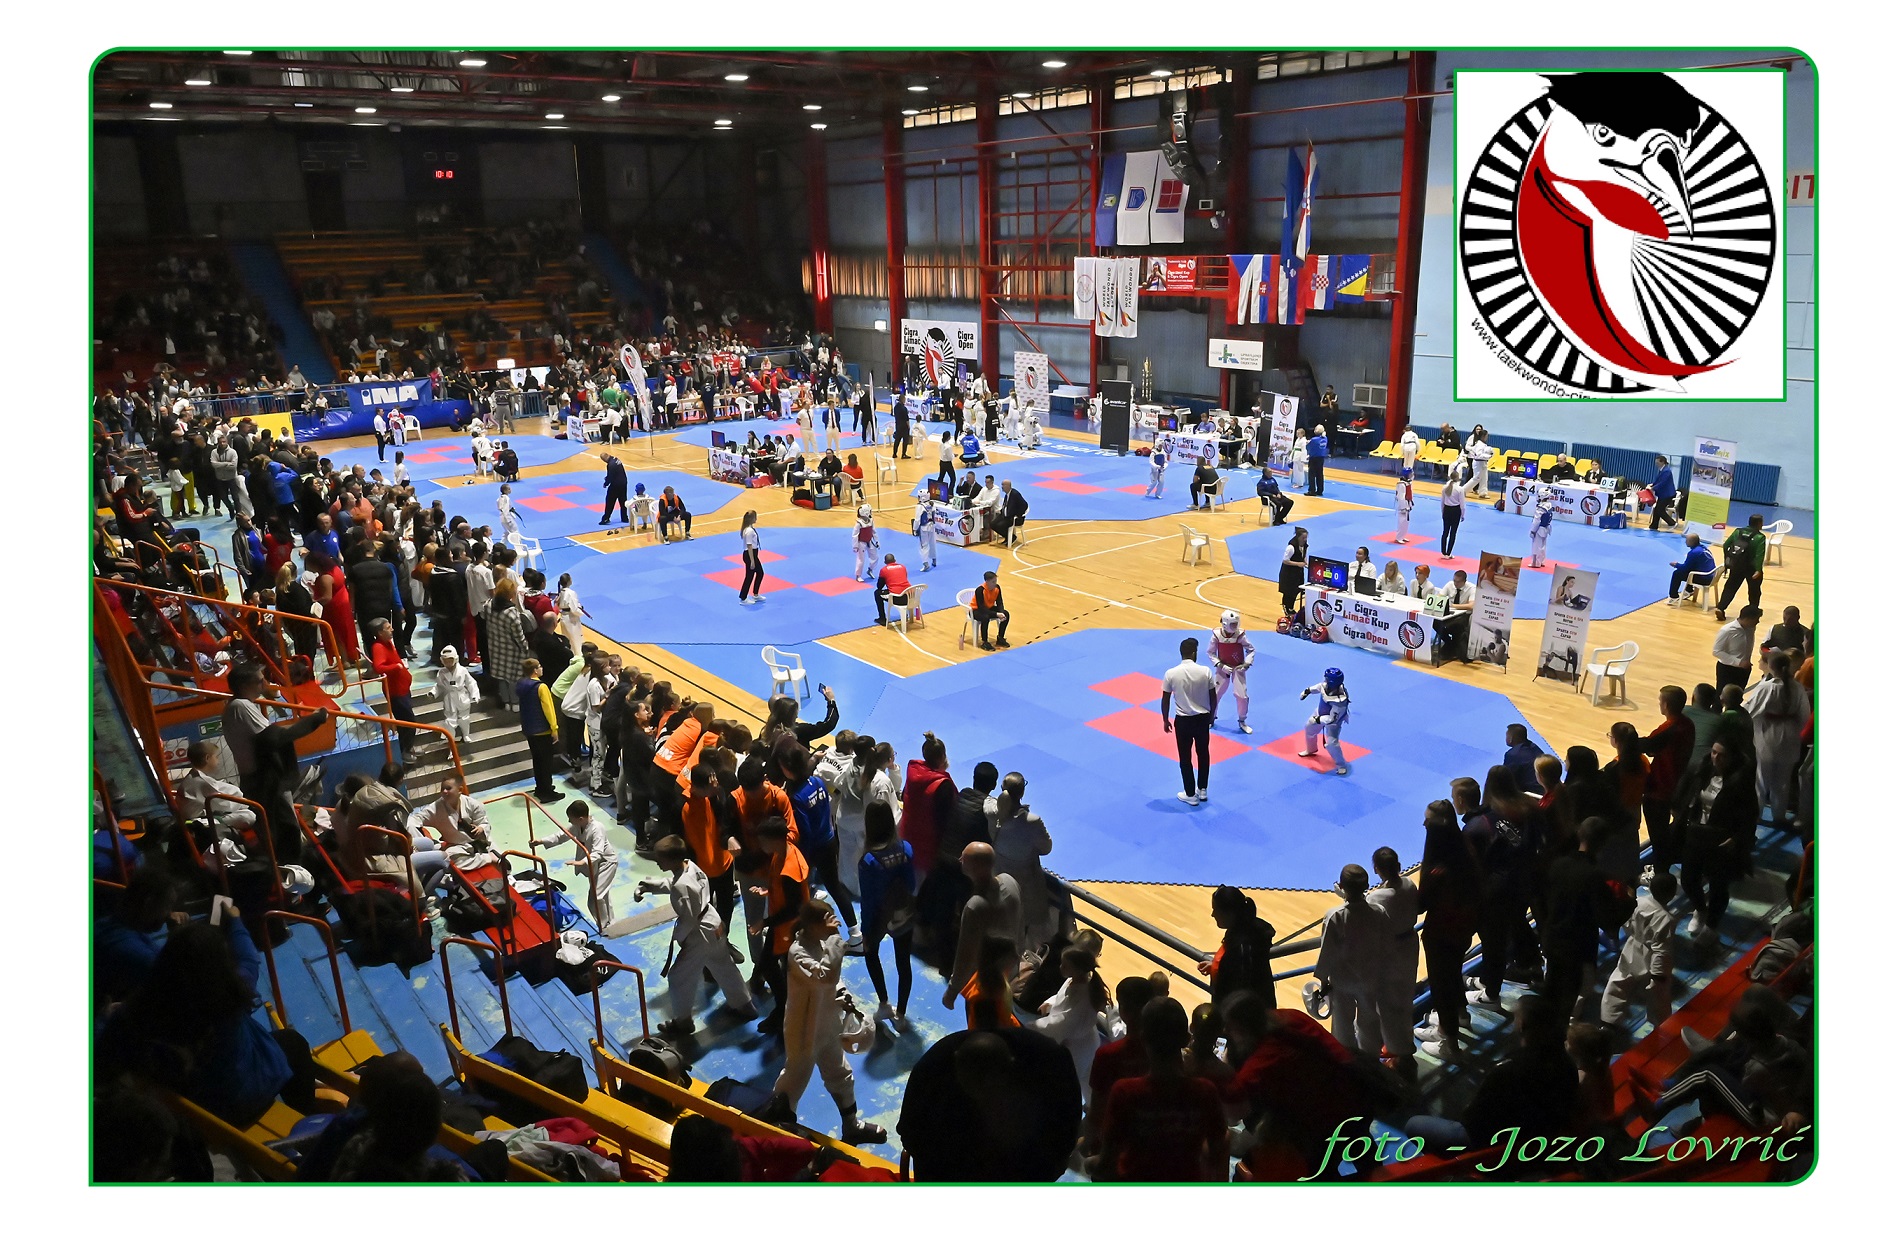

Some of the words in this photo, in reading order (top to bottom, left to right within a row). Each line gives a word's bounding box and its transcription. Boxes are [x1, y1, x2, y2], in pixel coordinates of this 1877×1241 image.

[904, 325, 918, 338] Čigra
[957, 328, 974, 341] Čigra
[904, 344, 915, 354] Kup
[958, 340, 974, 350] Open
[1529, 485, 1536, 494] 4
[1560, 495, 1574, 504] Kup
[1334, 572, 1339, 580] 0
[1334, 599, 1343, 612] 5
[1426, 597, 1434, 607] 0
[1436, 601, 1444, 609] 4
[1354, 602, 1378, 617] Čigra
[1343, 610, 1370, 624] Limač
[1371, 618, 1390, 631] Kup
[1343, 624, 1389, 646] ČigraOpen
